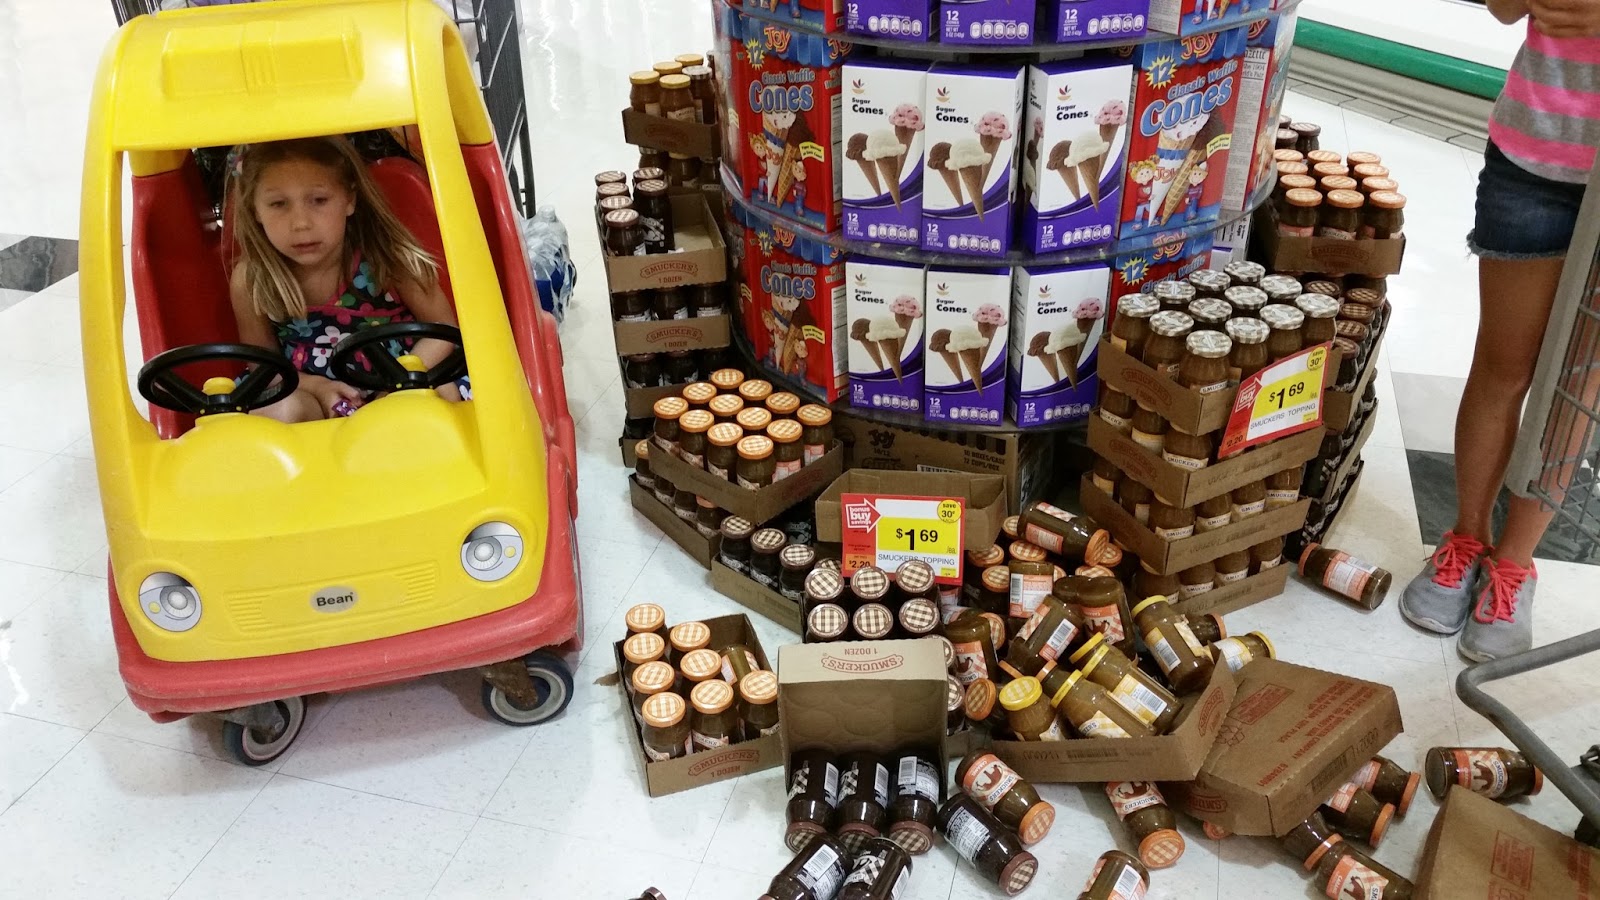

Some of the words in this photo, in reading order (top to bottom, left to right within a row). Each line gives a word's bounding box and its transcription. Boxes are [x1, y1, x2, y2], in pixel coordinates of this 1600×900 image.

[848, 3, 858, 13] 12
[946, 10, 959, 20] 12
[1065, 9, 1077, 19] 12
[787, 68, 815, 83] Waffle
[1150, 62, 1172, 84] 12
[1168, 76, 1206, 100] Classic
[1208, 59, 1238, 84] Waffle
[749, 80, 814, 114] Cones
[852, 104, 884, 115] Cones
[1140, 76, 1234, 136] Cones
[936, 113, 969, 124] Cones
[1056, 110, 1089, 120] Cones
[848, 213, 858, 221] 12
[928, 223, 938, 232] 12
[1043, 225, 1053, 234] 12
[1126, 260, 1144, 282] 12
[761, 265, 816, 300] Cones
[855, 295, 884, 304] Cones
[936, 304, 967, 313] Cones
[1037, 306, 1068, 315] Cones
[1250, 413, 1284, 429] SMUCKERS
[1288, 403, 1316, 416] TOPPING
[850, 512, 871, 522] buy
[878, 554, 918, 563] SMUCKERS
[923, 556, 954, 565] TOPPING
[316, 595, 353, 606] Bean
[828, 654, 898, 672] SMUCKER'S
[717, 765, 740, 776] DOZEN
